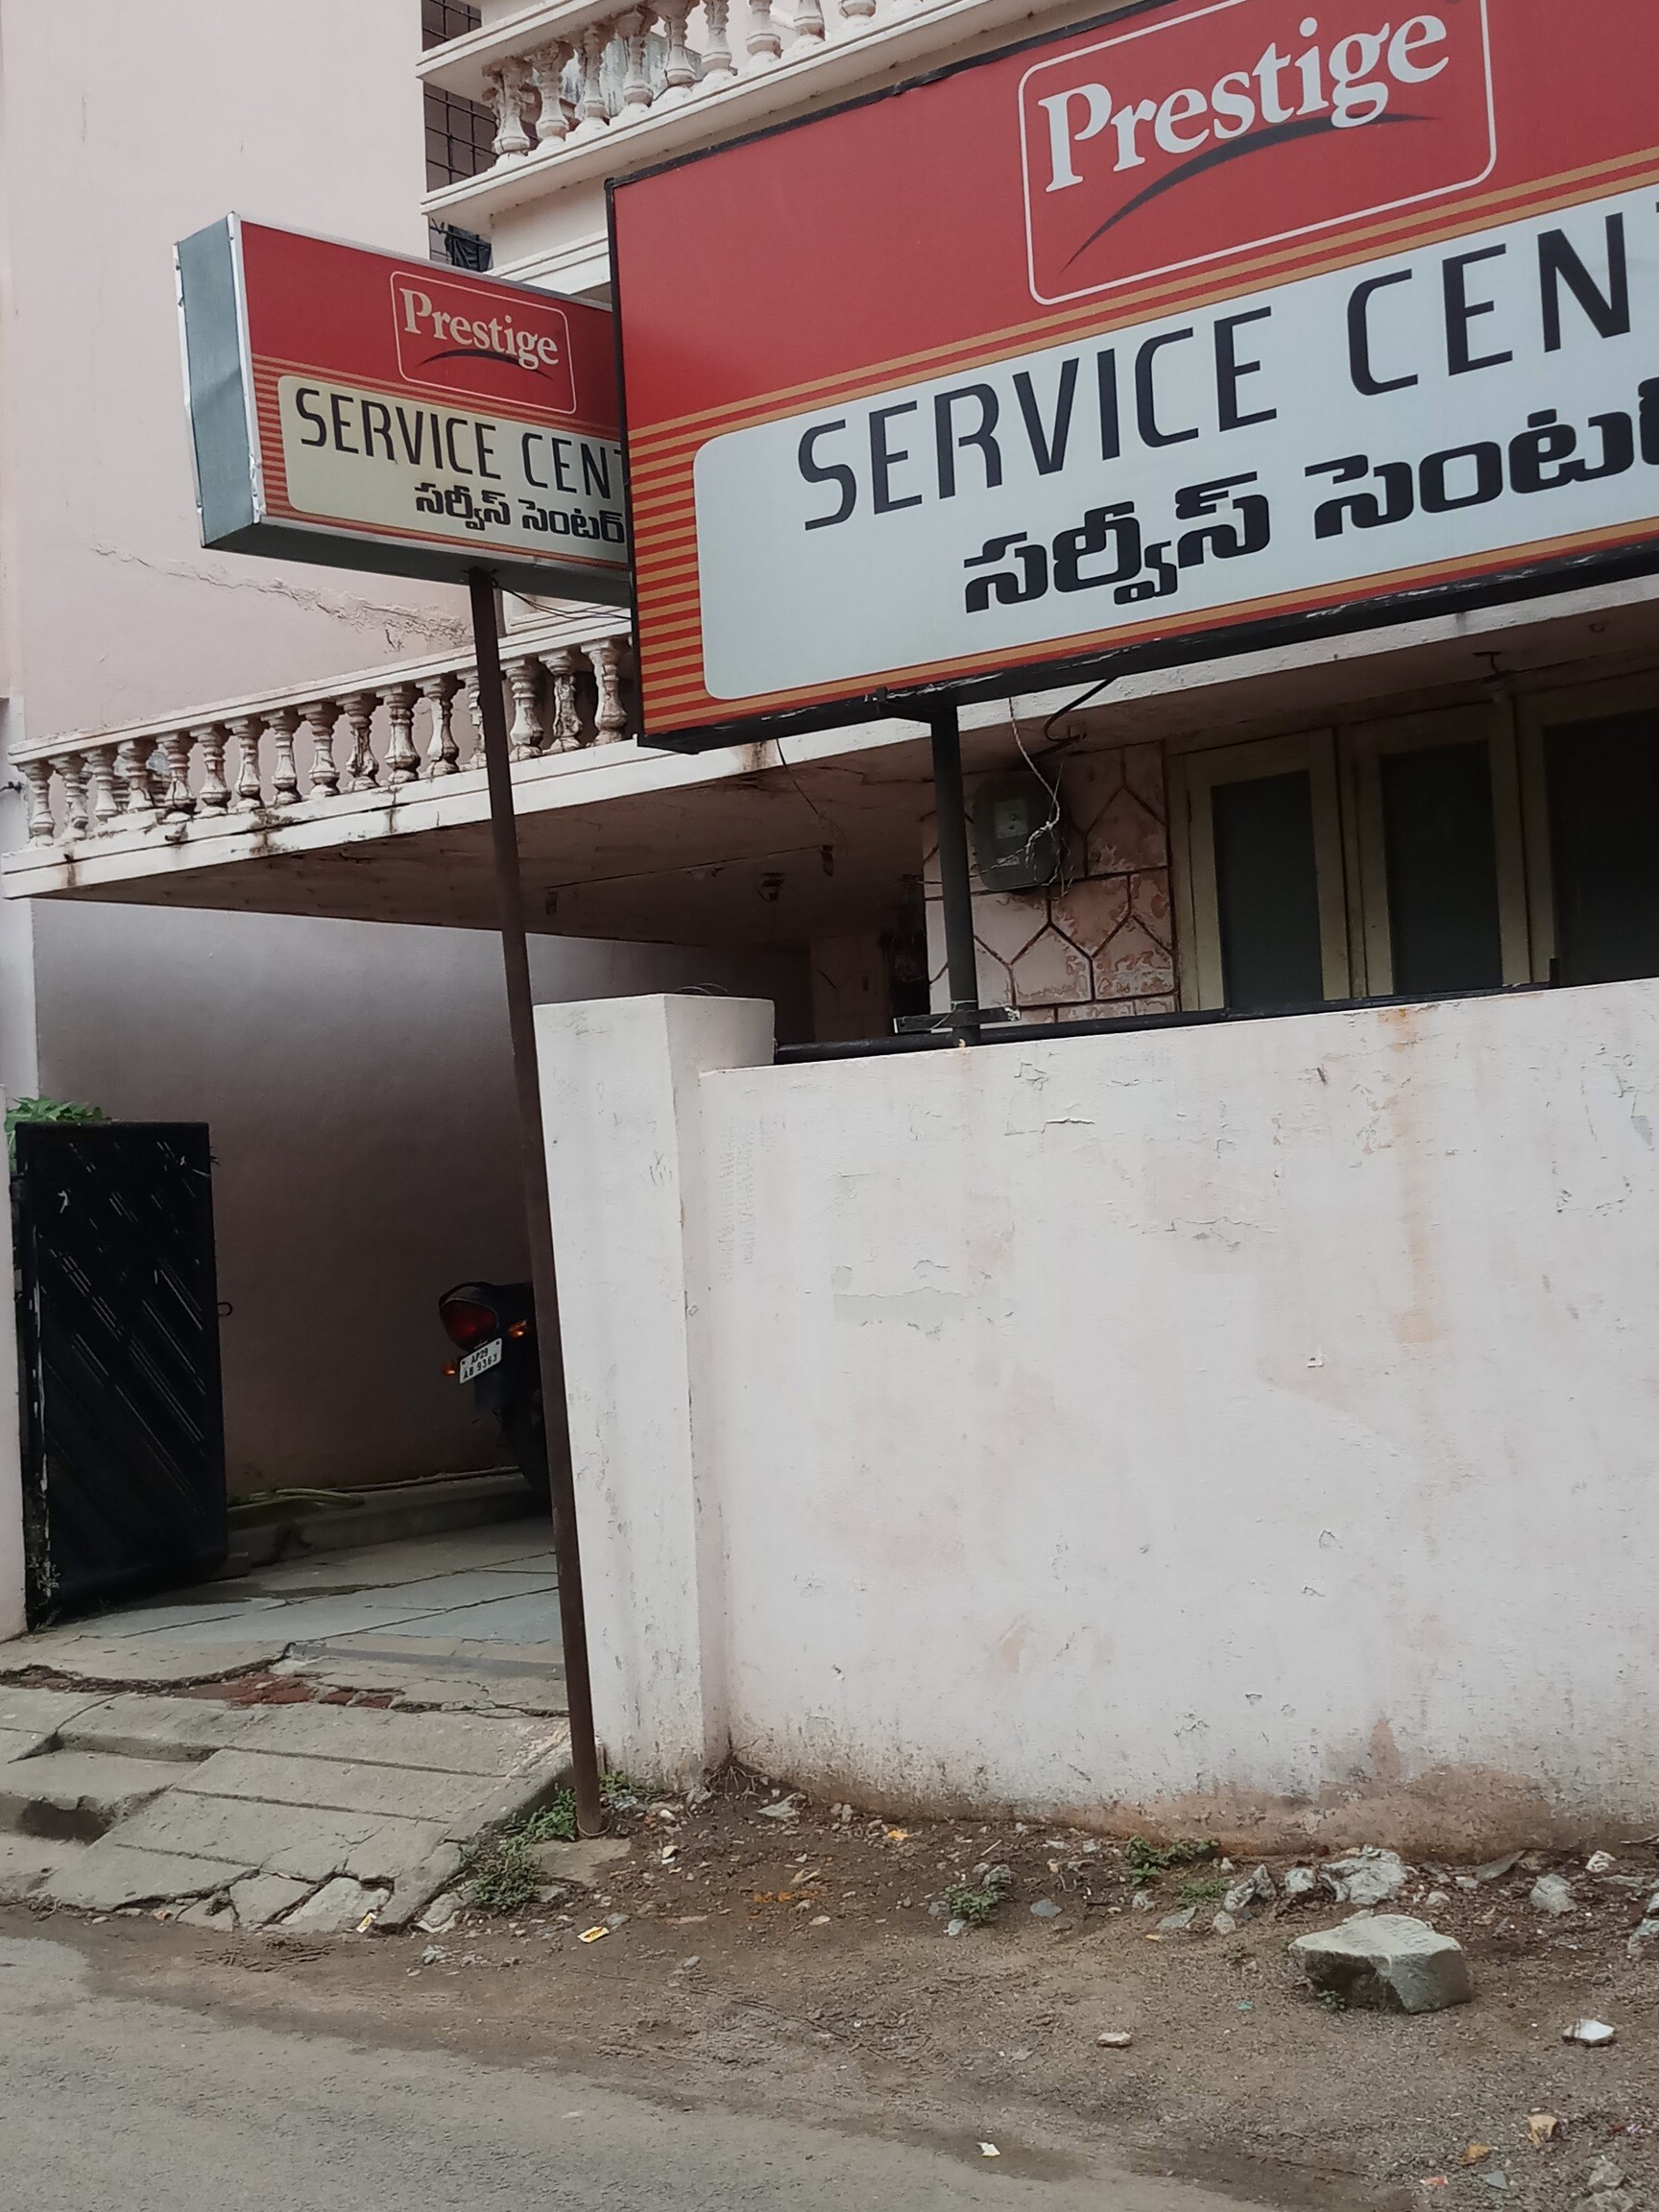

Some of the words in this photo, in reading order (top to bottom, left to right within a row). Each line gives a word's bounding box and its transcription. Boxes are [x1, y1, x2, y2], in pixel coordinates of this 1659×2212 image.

[1038, 15, 1451, 193] Prestige
[399, 287, 560, 371] Prestige
[798, 306, 1278, 531] SERVICE
[1347, 202, 1659, 397] CEN
[296, 387, 502, 480] SERVICE
[964, 471, 1270, 613] సర్వీస్
[1305, 375, 1659, 540] సెంట
[415, 482, 512, 531] సర్వీస్
